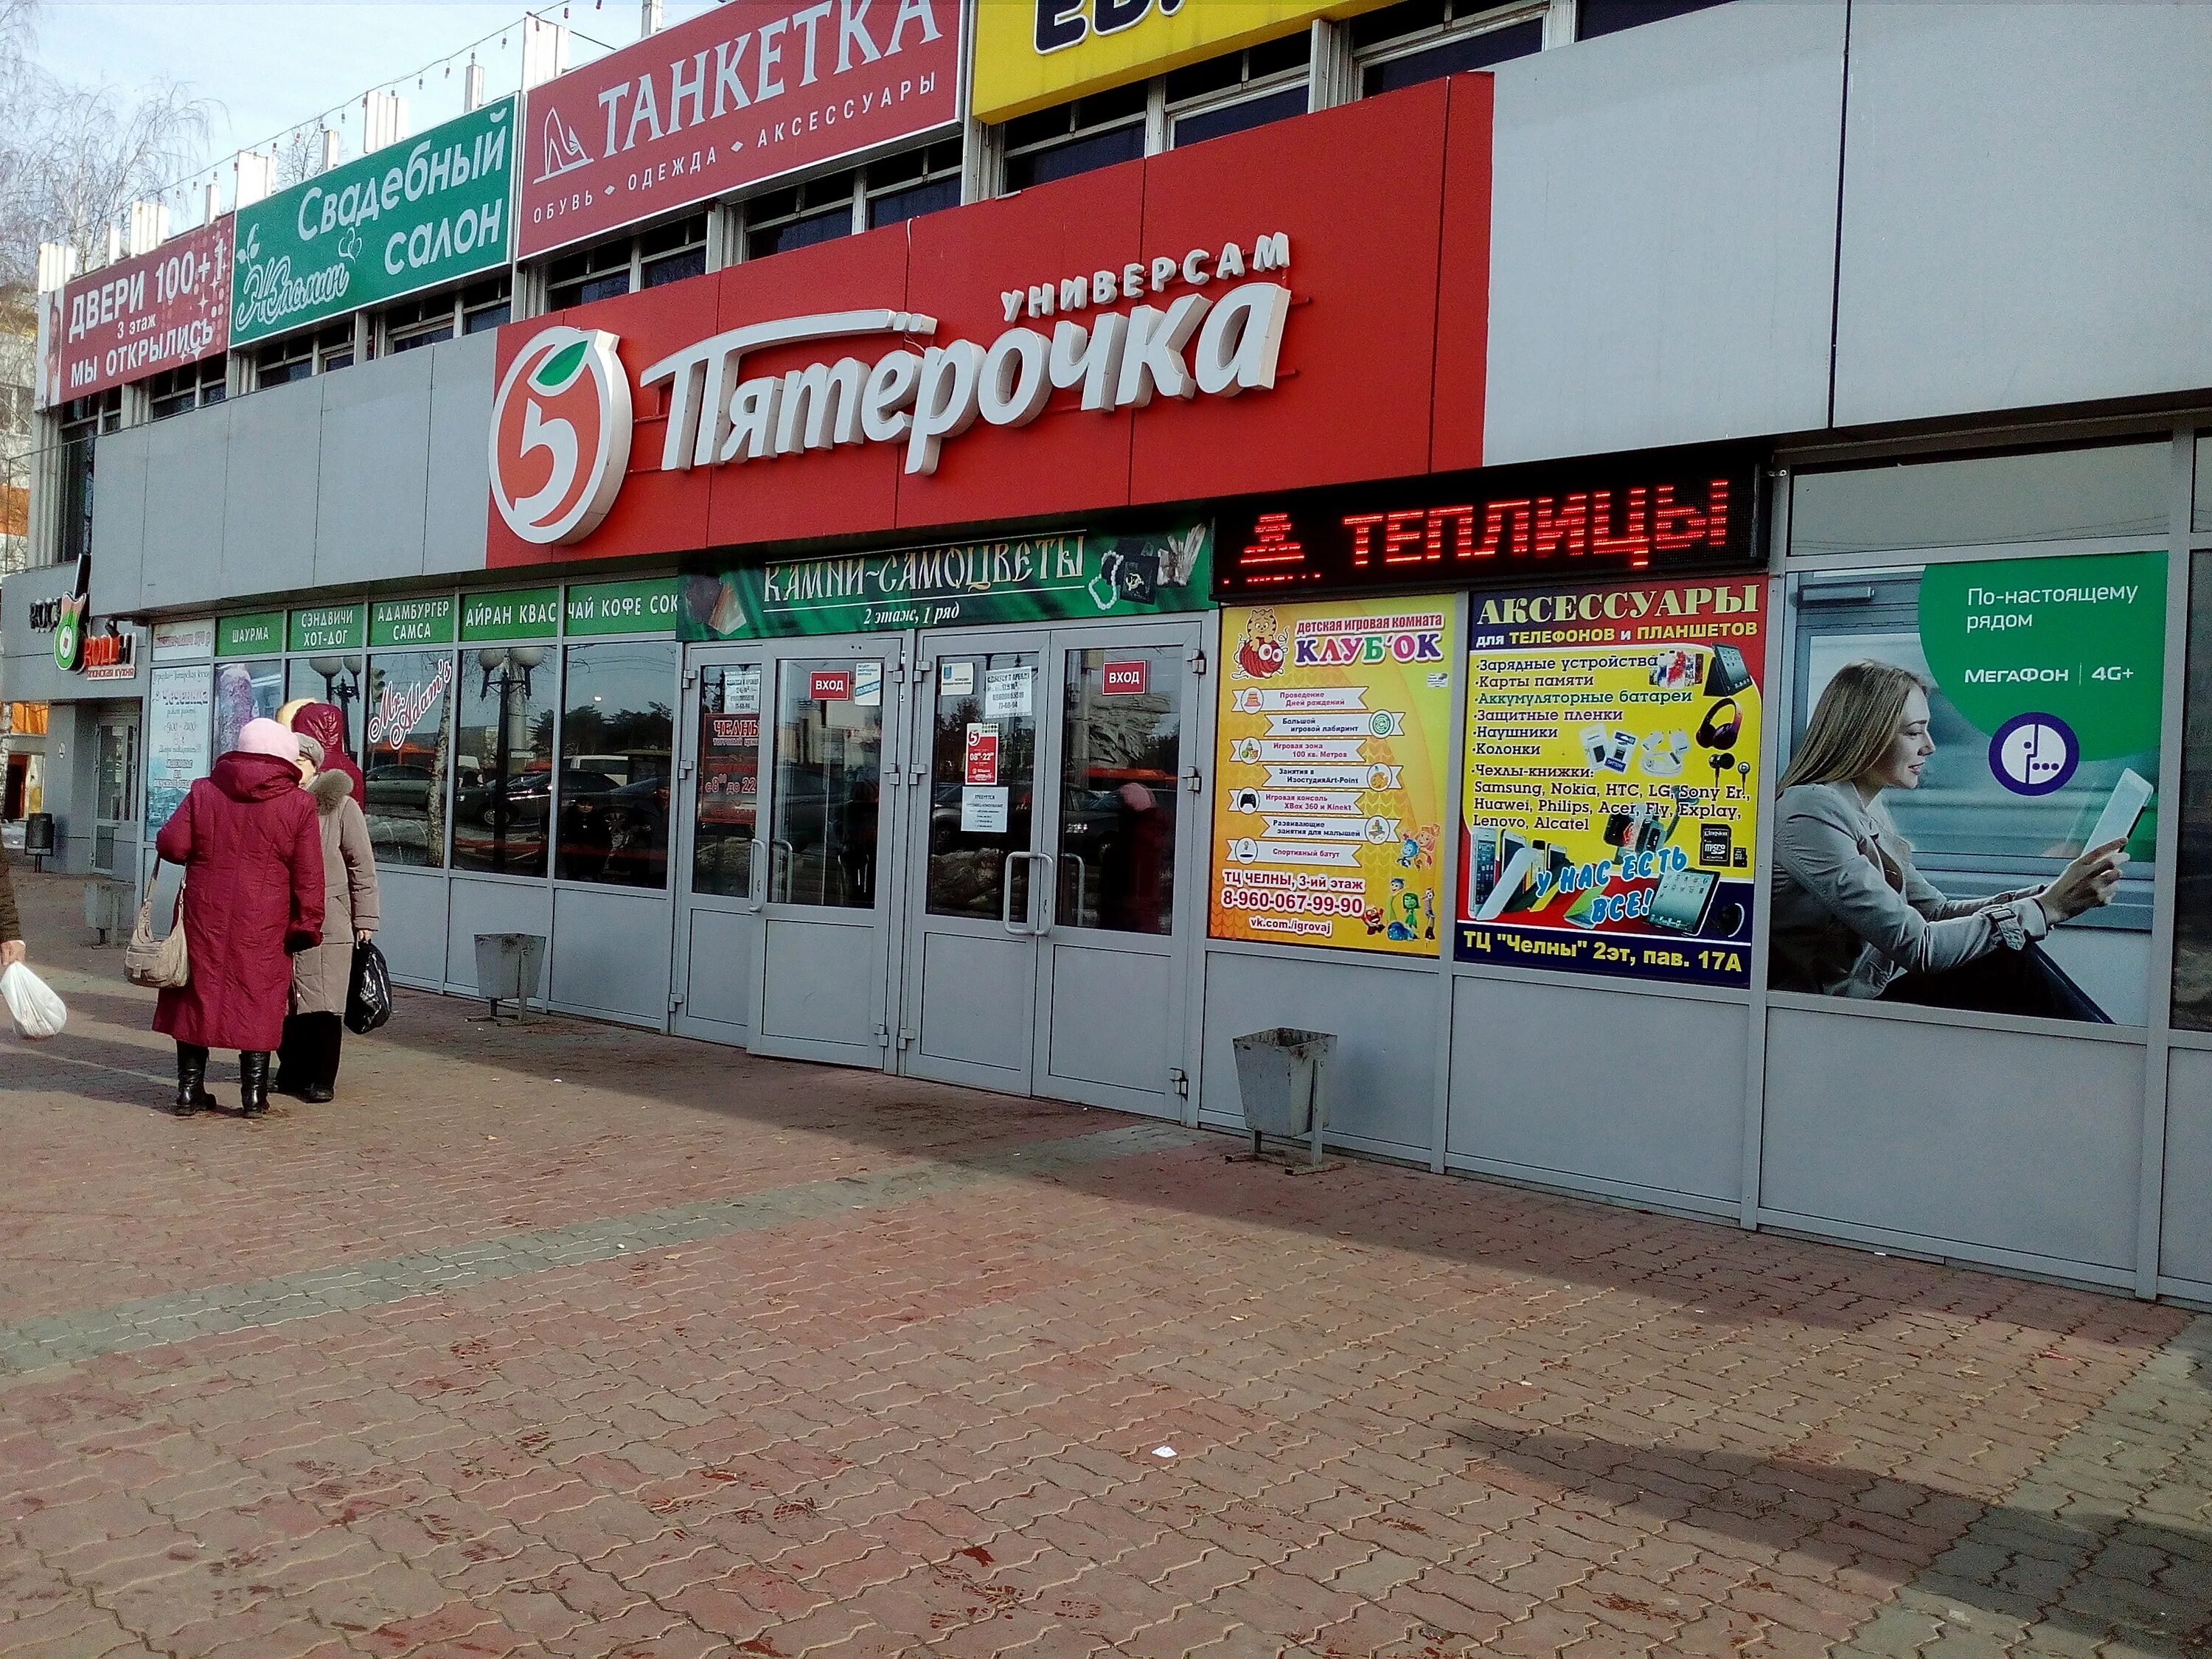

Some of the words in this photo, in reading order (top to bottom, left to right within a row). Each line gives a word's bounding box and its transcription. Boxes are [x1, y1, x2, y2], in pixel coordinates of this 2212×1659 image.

[597, 0, 943, 158] ТАНКЕТКА
[534, 189, 592, 223] ОБУВЬ
[627, 146, 716, 191] ОДЕЖДА
[757, 72, 935, 147] АКСЕССУАРЫ
[298, 108, 507, 241] Свадебный
[384, 198, 503, 275] салон
[1001, 232, 1290, 322] УНИВЕРСАМ
[69, 271, 145, 343] ДВЕРИ
[117, 323, 124, 339] 3
[129, 313, 156, 335] этаж
[71, 355, 97, 388] МЫ
[105, 318, 214, 377] ОТКРЫЛИСЬ
[1344, 479, 1729, 566] ТЕПЛИЦЫ
[1476, 585, 1760, 625] АКСЕССУАРЫ
[1968, 585, 2138, 606] По-настоящему
[378, 601, 449, 622] АДАМБУРГЕР
[466, 602, 512, 627] АЙРАН
[519, 602, 557, 624] КВАС
[568, 597, 594, 619] ЧАЙ
[602, 597, 641, 617] КОФЕ
[650, 594, 678, 614] СОК
[863, 608, 872, 625] 2
[924, 607, 931, 625] 1
[933, 602, 959, 627] ряд
[302, 610, 353, 627] СЭНДВИЧИ
[1297, 620, 1341, 634] детская
[1345, 617, 1389, 632] игровая
[1392, 614, 1441, 627] комната
[1966, 613, 2033, 633] рядом
[232, 627, 269, 643] ШАУРМА
[304, 630, 348, 647] ХОТ-ДОГ
[393, 623, 431, 641] САМСА
[1476, 635, 1504, 647] для
[1509, 628, 1615, 644] ТЕЛЕФОНОВ
[1621, 630, 1631, 640] и
[1637, 622, 1758, 639] ПЛАНШЕТОВ
[1481, 658, 1555, 672] Зарядные
[1561, 655, 1658, 671] устройства
[1108, 671, 1140, 684] ВХОД
[1479, 676, 1529, 689] Карты
[1535, 675, 1594, 687] памяти
[2091, 667, 2134, 681] 4G+
[815, 679, 844, 692] ВХОД
[1280, 692, 1324, 700] Проведение
[1307, 699, 1345, 707] рождений
[1478, 692, 1613, 706] Аккумуляторные
[1619, 690, 1692, 704] батареи
[369, 681, 405, 743] Mr.
[1478, 710, 1558, 723] Защитные
[1564, 710, 1622, 720] пленки
[1290, 725, 1320, 733] игровой
[1322, 725, 1358, 733] лабиринт
[1477, 726, 1557, 740] Наушники
[1476, 743, 1540, 754] Колонки
[1475, 765, 1594, 777] Чехлы-книжки:
[726, 782, 740, 795] до
[1475, 782, 1545, 796] Samsung,
[1551, 783, 1600, 797] Nokia,
[1605, 784, 1642, 799] HTC,
[1649, 785, 1674, 799] LG,
[1679, 785, 1720, 801] Sony
[1474, 798, 1533, 812] Huawei,
[1538, 799, 1592, 814] Philips,
[1598, 801, 1637, 815] Acer,
[1646, 802, 1673, 818] Fly,
[1678, 804, 1742, 820] Explay,
[1273, 820, 1325, 828] Развивающие
[1472, 815, 1529, 830] Lenovo,
[1534, 816, 1589, 830] Alcatel
[1273, 848, 1318, 857] Спортивный
[1319, 850, 1340, 858] батут
[1559, 860, 1612, 893] НАС
[1621, 846, 1687, 881] ЕСТЬ
[1225, 872, 1240, 884] ТЦ
[1245, 873, 1295, 888] ЧЕЛНЫ,
[1299, 875, 1326, 888] 3-ий
[1330, 879, 1363, 889] этаж
[1223, 890, 1362, 914] 8-960-067-99-90
[1590, 888, 1655, 925] ВСЕ!
[1464, 931, 1491, 952] ТЦ
[1497, 933, 1587, 957] "Челны"
[1593, 942, 1635, 966] 2эт,
[1644, 950, 1689, 967] пав.
[1699, 950, 1742, 972] 17А
